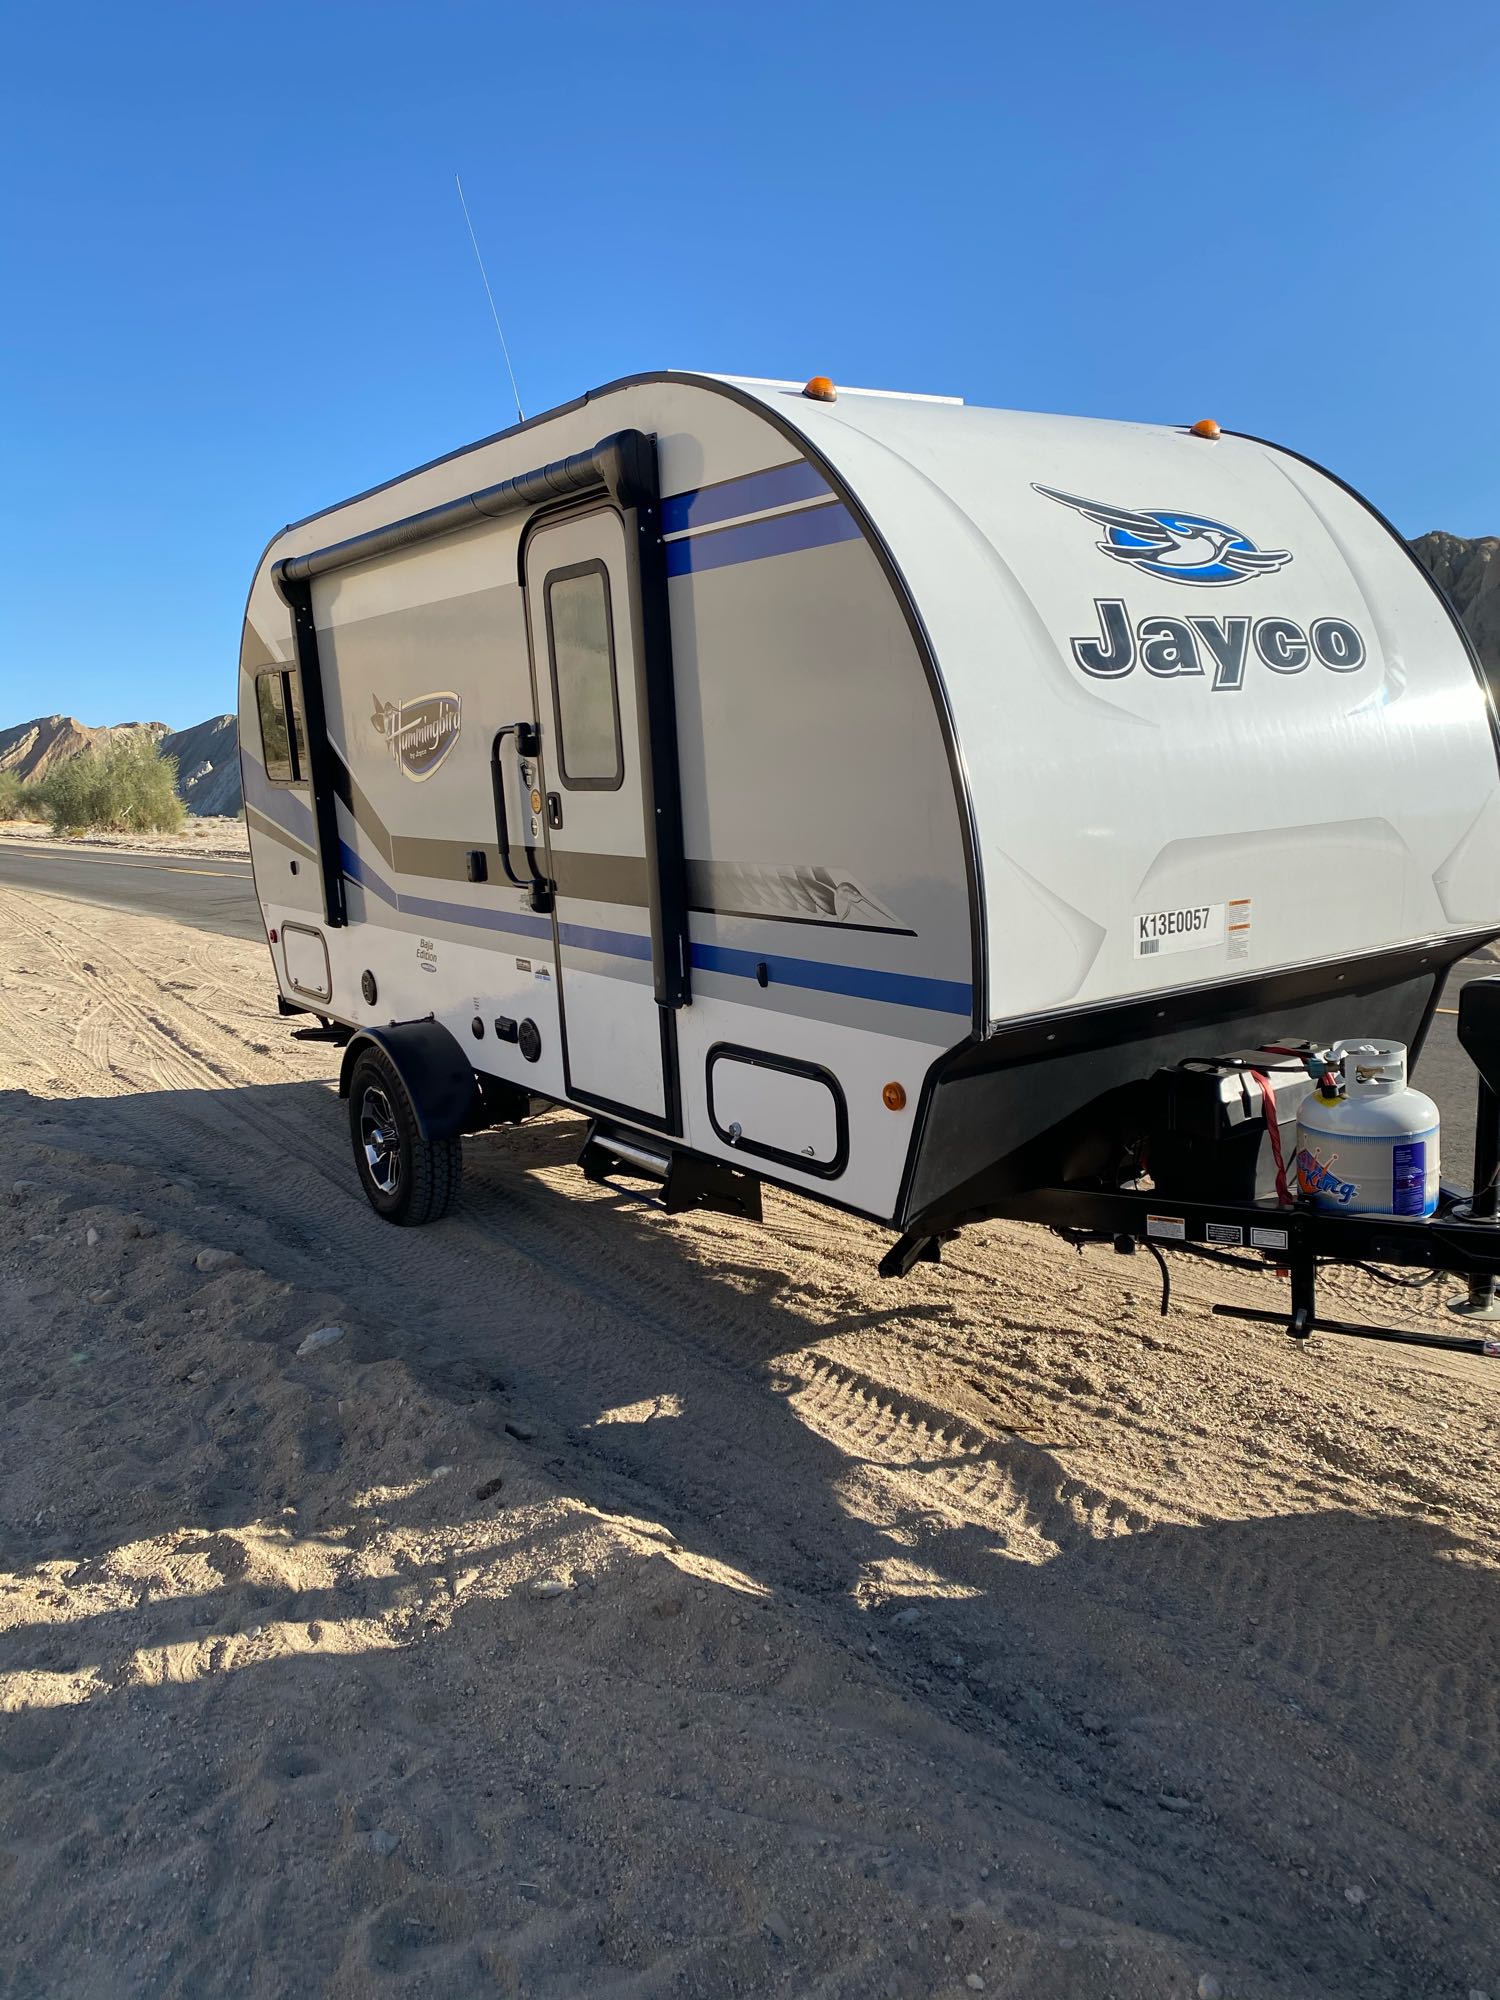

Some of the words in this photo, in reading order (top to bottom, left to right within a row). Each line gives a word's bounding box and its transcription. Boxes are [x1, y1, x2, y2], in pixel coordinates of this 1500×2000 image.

[1069, 598, 1367, 691] Jayco
[386, 695, 462, 775] Hummingbird
[1140, 908, 1210, 938] K13E0057
[416, 949, 437, 962] Edition
[420, 939, 433, 950] Baja
[1302, 1168, 1357, 1204] King
